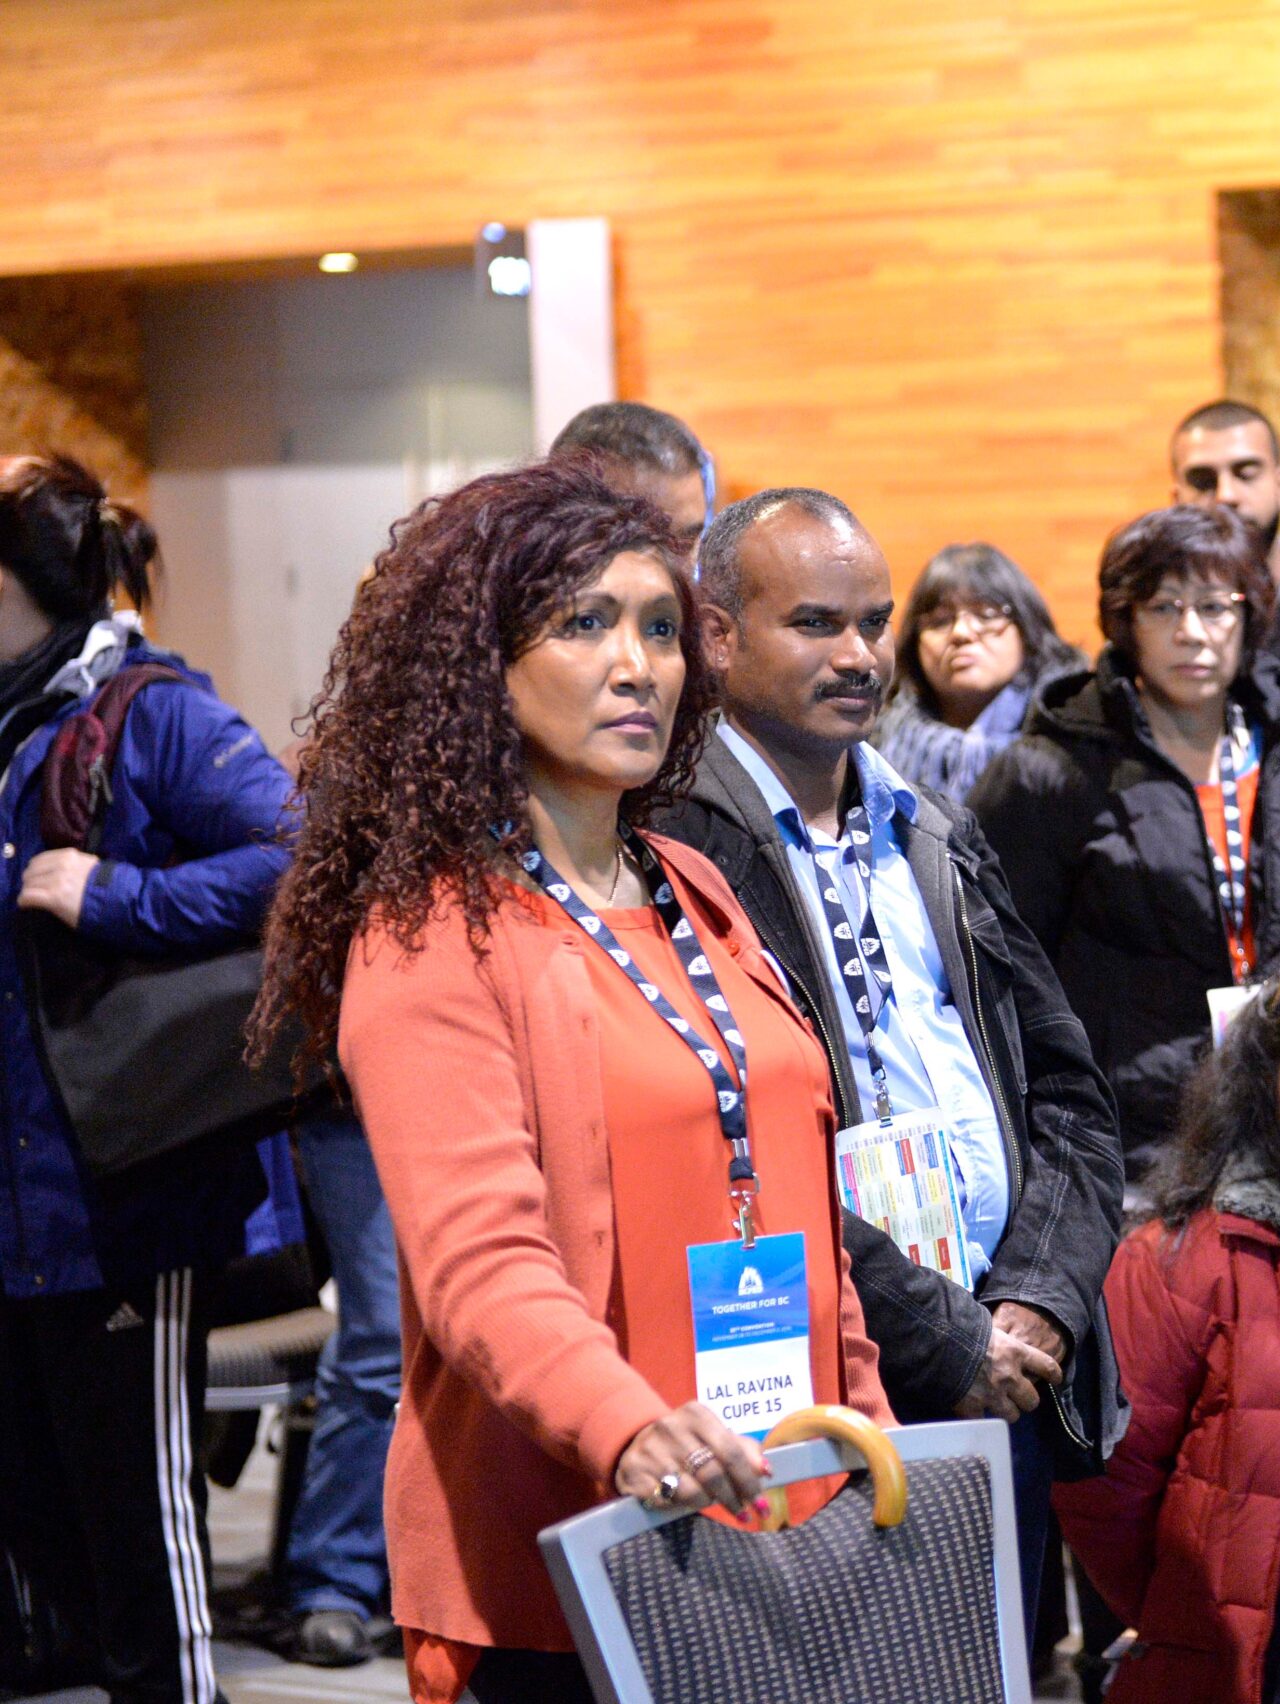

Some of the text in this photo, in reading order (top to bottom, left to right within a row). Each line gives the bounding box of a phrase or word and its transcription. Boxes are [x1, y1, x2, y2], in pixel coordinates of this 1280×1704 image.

[711, 1295, 790, 1315] TOGETHER FOR BC
[706, 1374, 793, 1401] LAL RAVINA
[722, 1397, 782, 1420] CUPE 15
